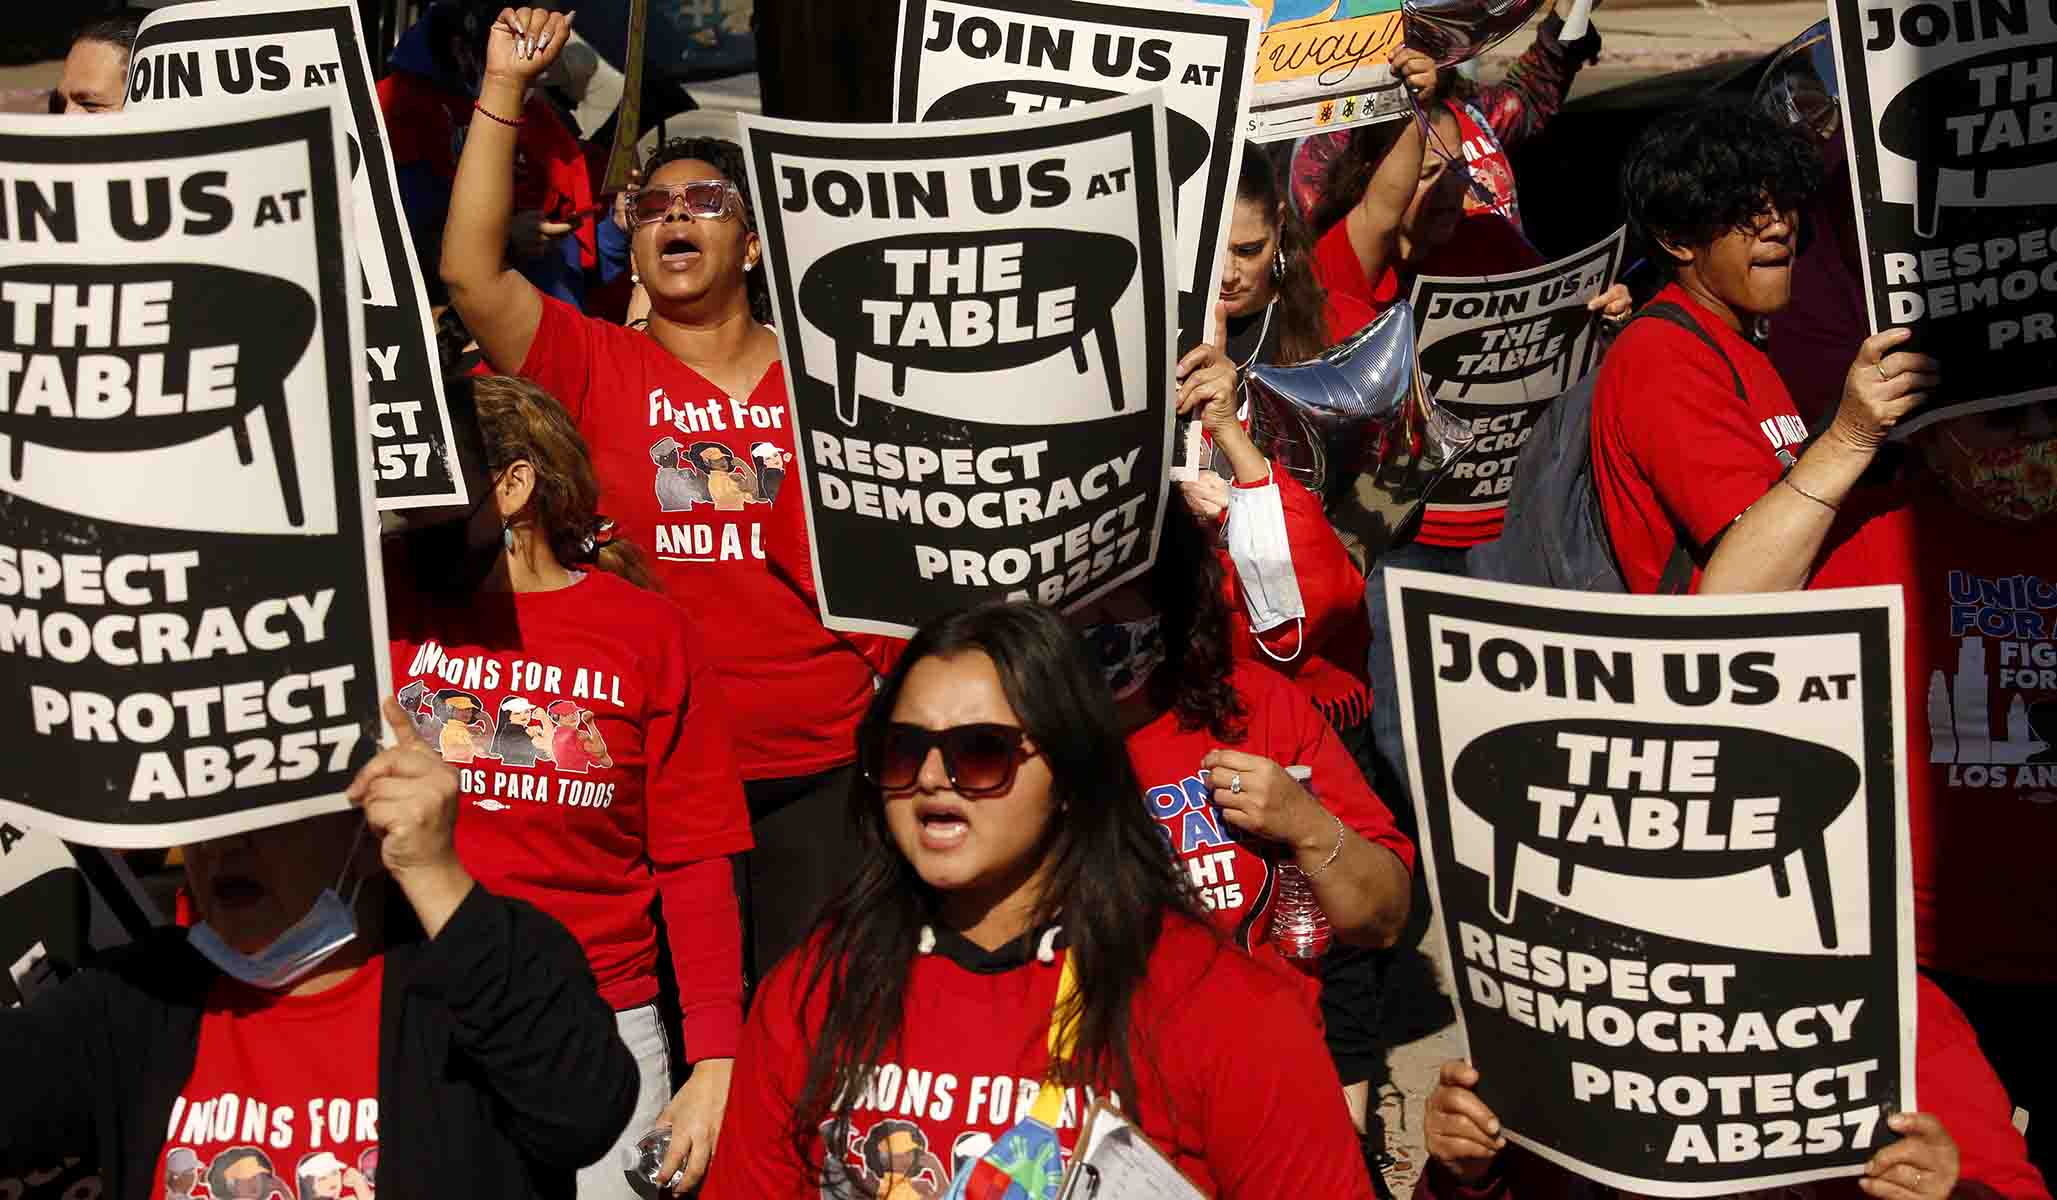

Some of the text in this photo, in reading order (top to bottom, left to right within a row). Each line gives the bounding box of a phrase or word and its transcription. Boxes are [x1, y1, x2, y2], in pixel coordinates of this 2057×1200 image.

[924, 9, 1221, 87] JOIN US AT
[1866, 0, 2029, 51] JOIN
[215, 44, 291, 95] US
[303, 62, 340, 88] AT
[107, 171, 234, 242] US
[253, 189, 308, 228] AT
[781, 158, 1131, 220] JOIN US AT
[883, 242, 1024, 296] THE
[1883, 227, 2057, 285] RESPE
[2, 279, 174, 348] THE
[862, 286, 1077, 349] TABLE
[1427, 271, 1606, 320] JOIN US AT
[1457, 333, 1566, 377] TABLE
[1480, 316, 1552, 352] THE
[728, 397, 785, 429] For
[810, 430, 1048, 486] RESPECT
[818, 447, 1143, 529] DEMOCRACY
[655, 524, 713, 555] AND
[719, 522, 745, 561] A
[915, 492, 1147, 587] PROTECT
[1950, 604, 2044, 639] FOR
[408, 640, 625, 708] UNIONS FOR ALL
[1438, 629, 1857, 707] JOIN US AT
[31, 664, 356, 743] PROTECT
[128, 722, 361, 802] AB257
[494, 771, 549, 803] PARA
[557, 778, 616, 809] TODOS
[1556, 731, 1721, 794] THE
[1948, 765, 2008, 788] LOS
[1526, 785, 1781, 852] TABLE
[1458, 921, 1737, 1006] RESPECT
[1465, 965, 1866, 1054] DEMOCRACY
[1570, 1058, 1880, 1117] PROTECT
[308, 1097, 379, 1149] FOR
[1664, 1104, 1882, 1166] AB257
